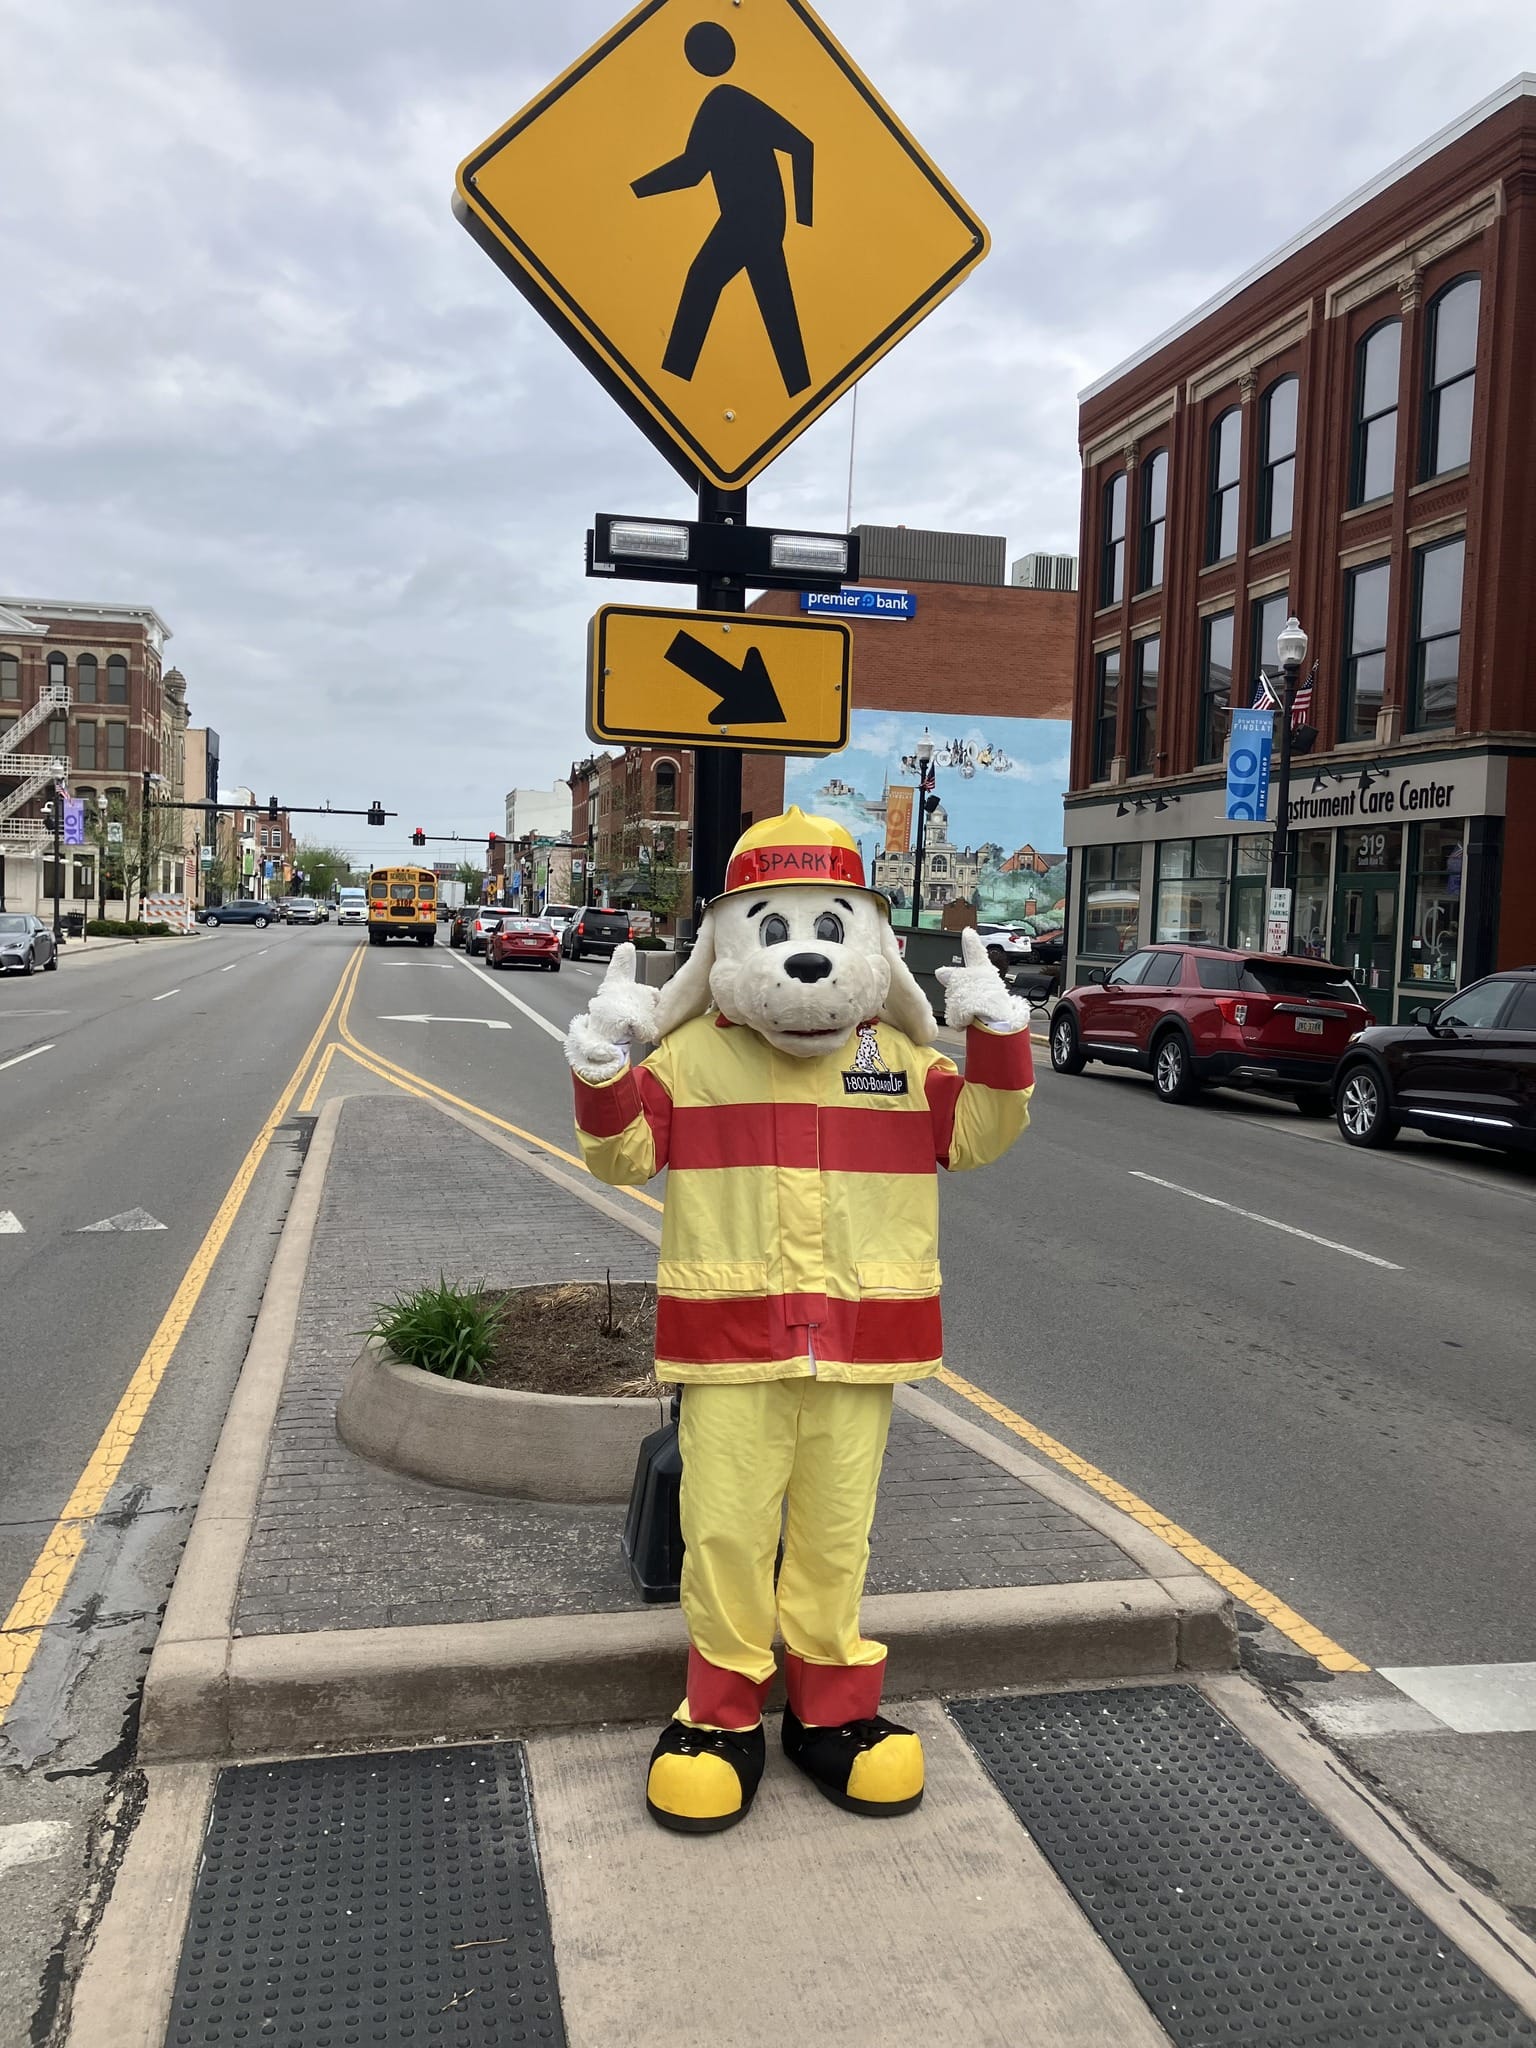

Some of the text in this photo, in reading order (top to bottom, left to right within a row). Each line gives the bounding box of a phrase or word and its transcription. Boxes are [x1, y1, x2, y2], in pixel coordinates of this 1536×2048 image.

[808, 592, 909, 610] premier bank
[1233, 723, 1272, 732] FINDLAY
[1287, 779, 1455, 821] nstrument Care Center
[1359, 834, 1385, 856] 319
[758, 852, 839, 873] SPARKY
